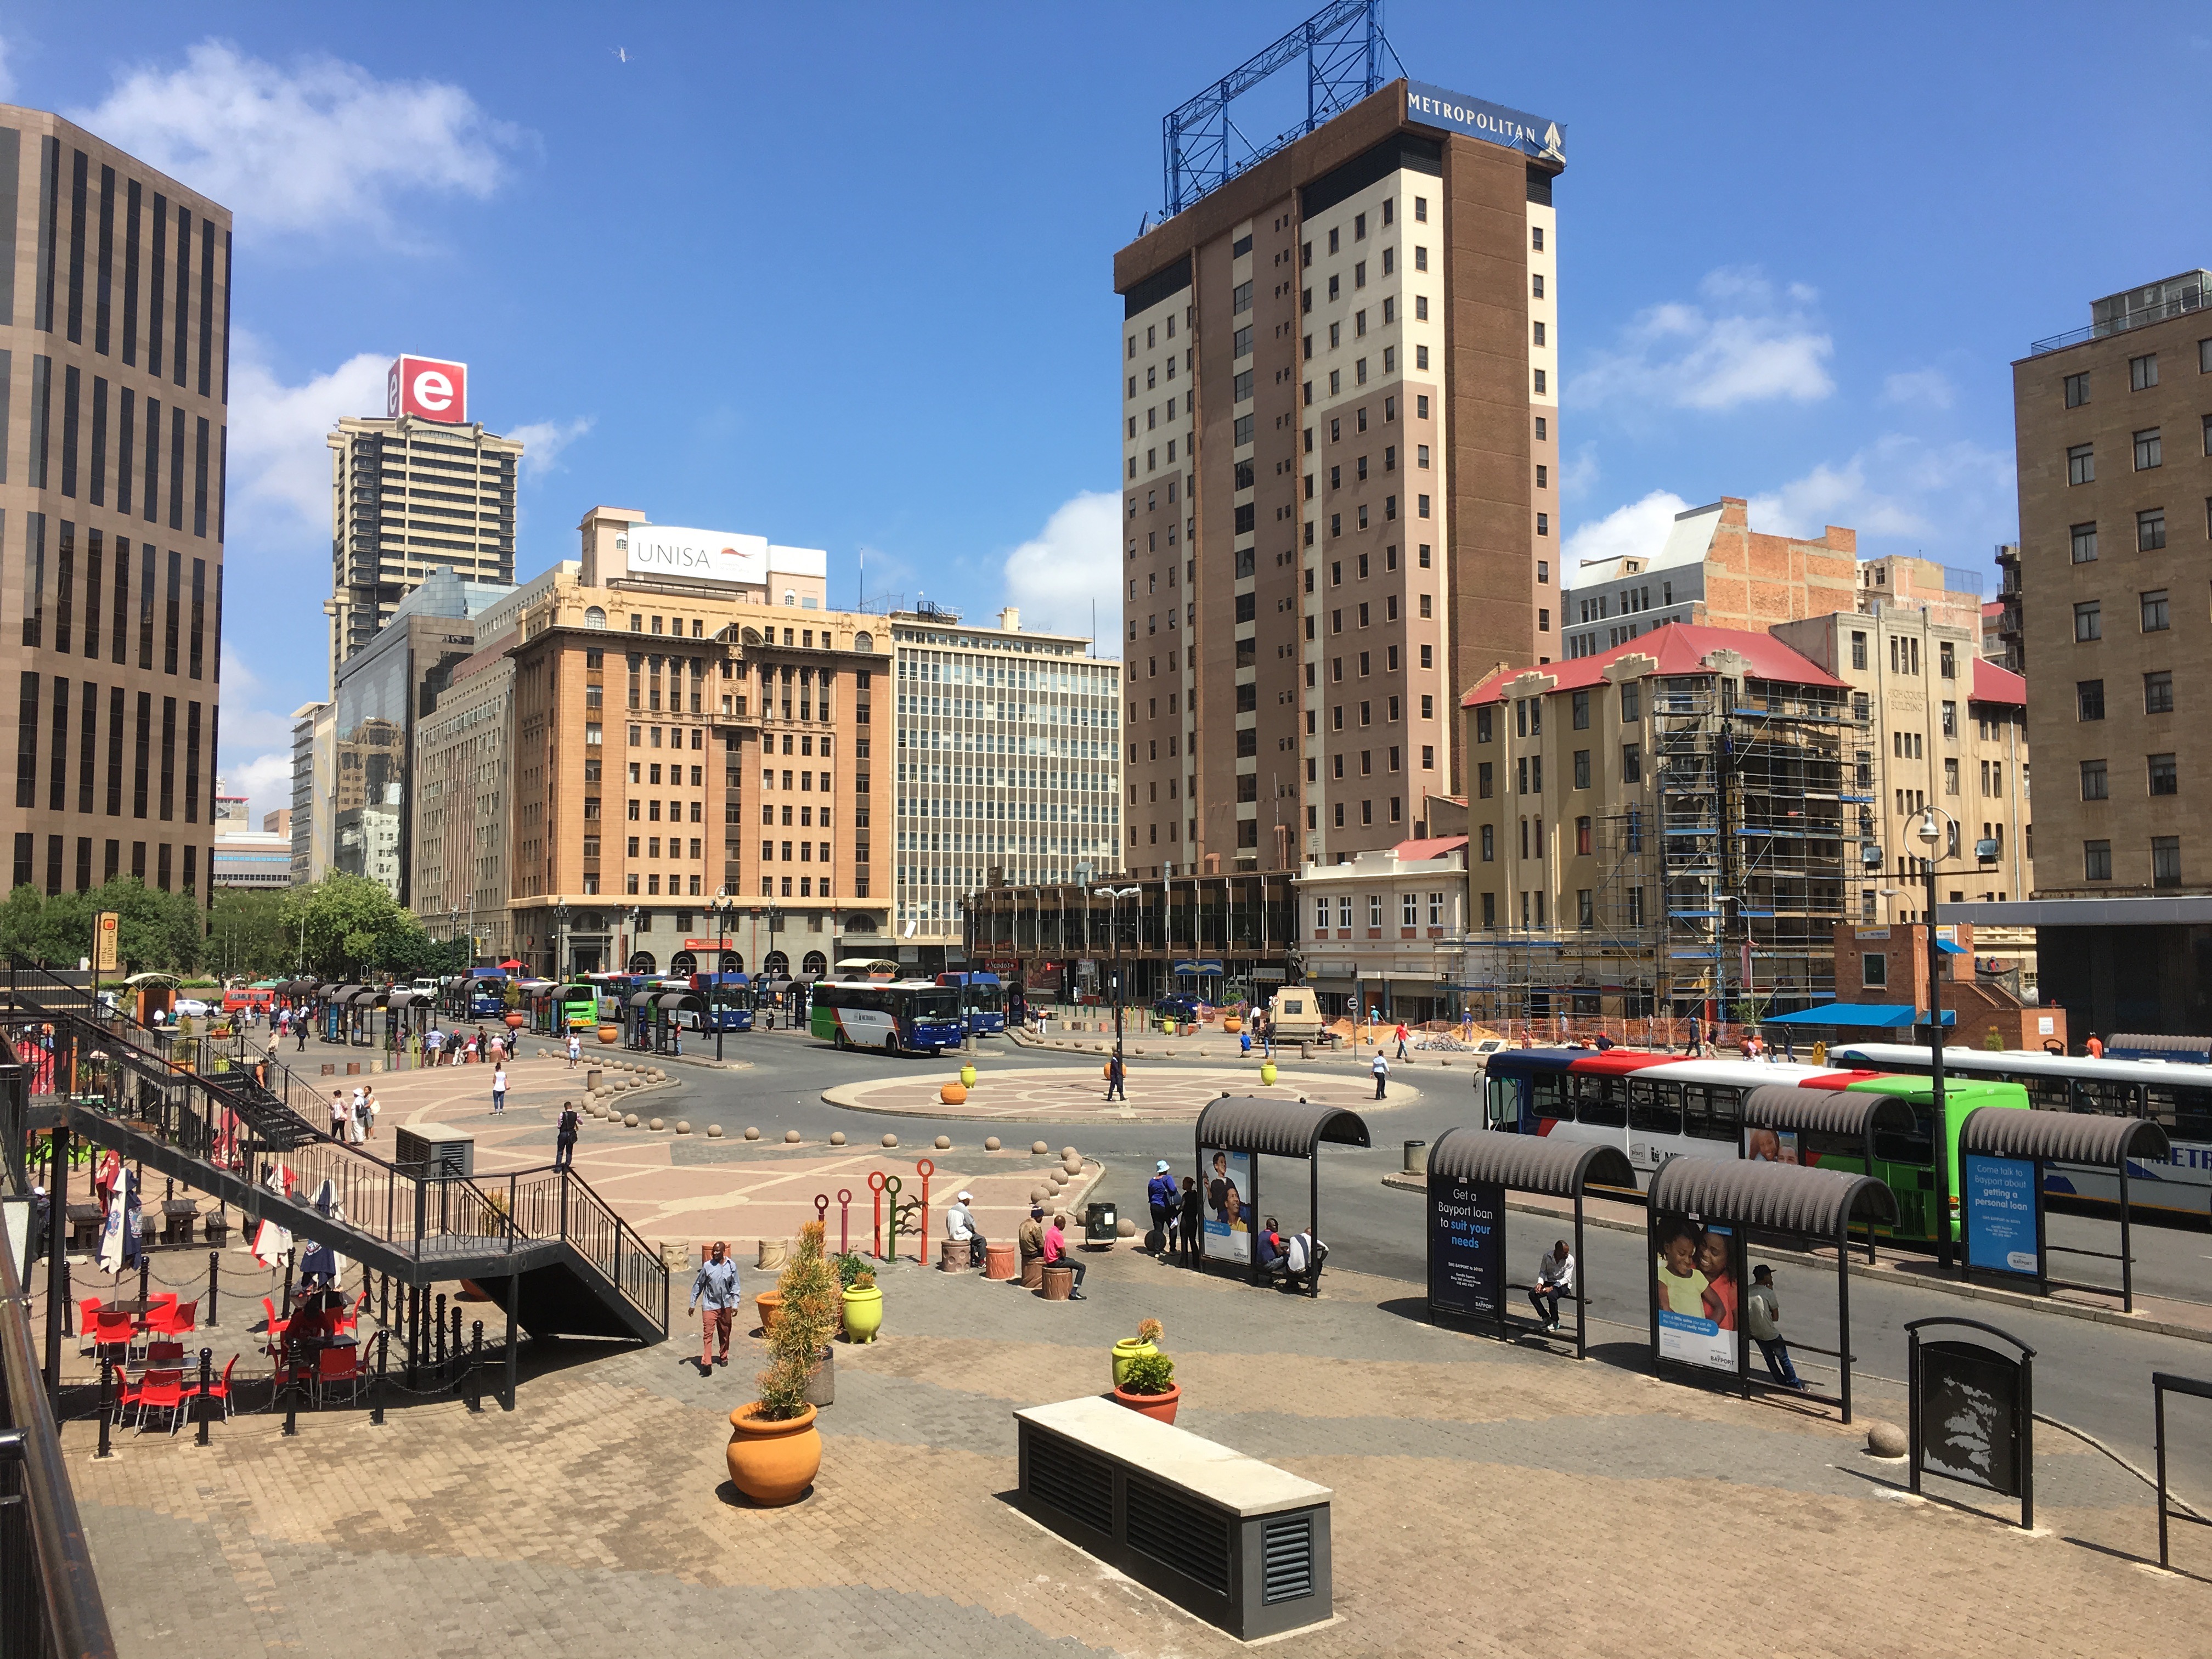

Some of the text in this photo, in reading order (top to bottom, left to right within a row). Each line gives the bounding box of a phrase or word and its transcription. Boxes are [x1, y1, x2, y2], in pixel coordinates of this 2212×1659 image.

[1408, 92, 1535, 143] METROPOLITAN
[413, 371, 453, 411] e
[637, 543, 710, 568] UNISA
[1891, 701, 1923, 712] BUILDING
[107, 931, 115, 964] Gandhi
[990, 961, 1011, 969] Nando's
[1977, 1165, 1999, 1175] Come
[2001, 1167, 2013, 1176] talk
[1975, 1175, 2026, 1188] Bayport about
[1453, 1188, 1476, 1201] Get a
[1983, 1188, 2010, 1199] getting
[1438, 1201, 1493, 1220] Bayport loan
[1975, 1198, 2027, 1211] personal loan
[1440, 1217, 1491, 1234] to suit your
[1452, 1236, 1479, 1249] needs
[1475, 1301, 1494, 1310] BAYPORT
[1711, 1356, 1735, 1365] BAYPORT
